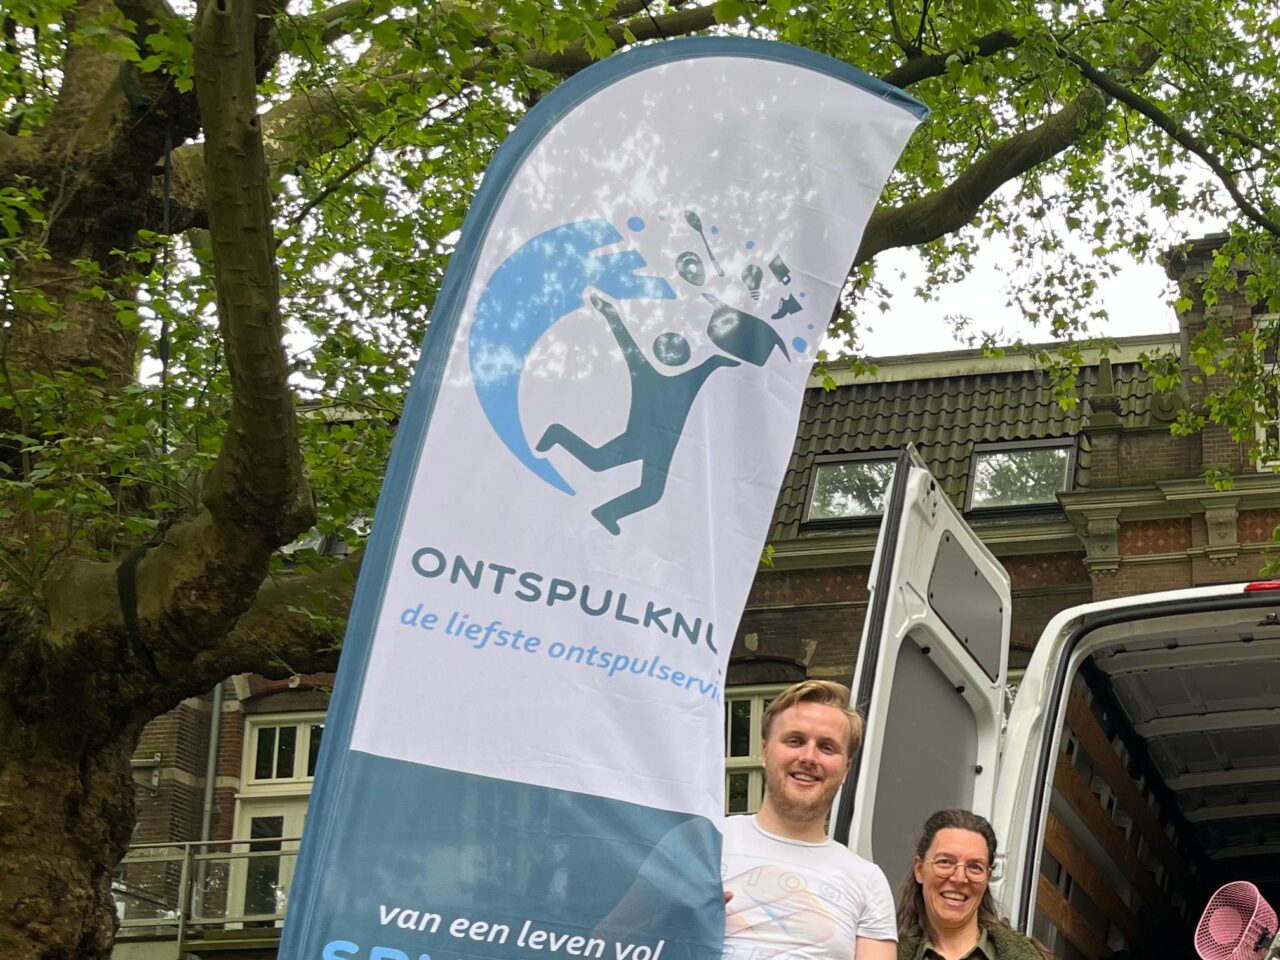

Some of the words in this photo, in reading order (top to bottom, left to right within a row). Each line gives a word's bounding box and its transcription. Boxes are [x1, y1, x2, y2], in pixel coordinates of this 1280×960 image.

[400, 602, 439, 630] de
[444, 611, 541, 653] liefste
[547, 641, 720, 704] ontspulservi
[379, 904, 442, 933] van
[449, 916, 510, 945] een
[516, 920, 606, 958] leven
